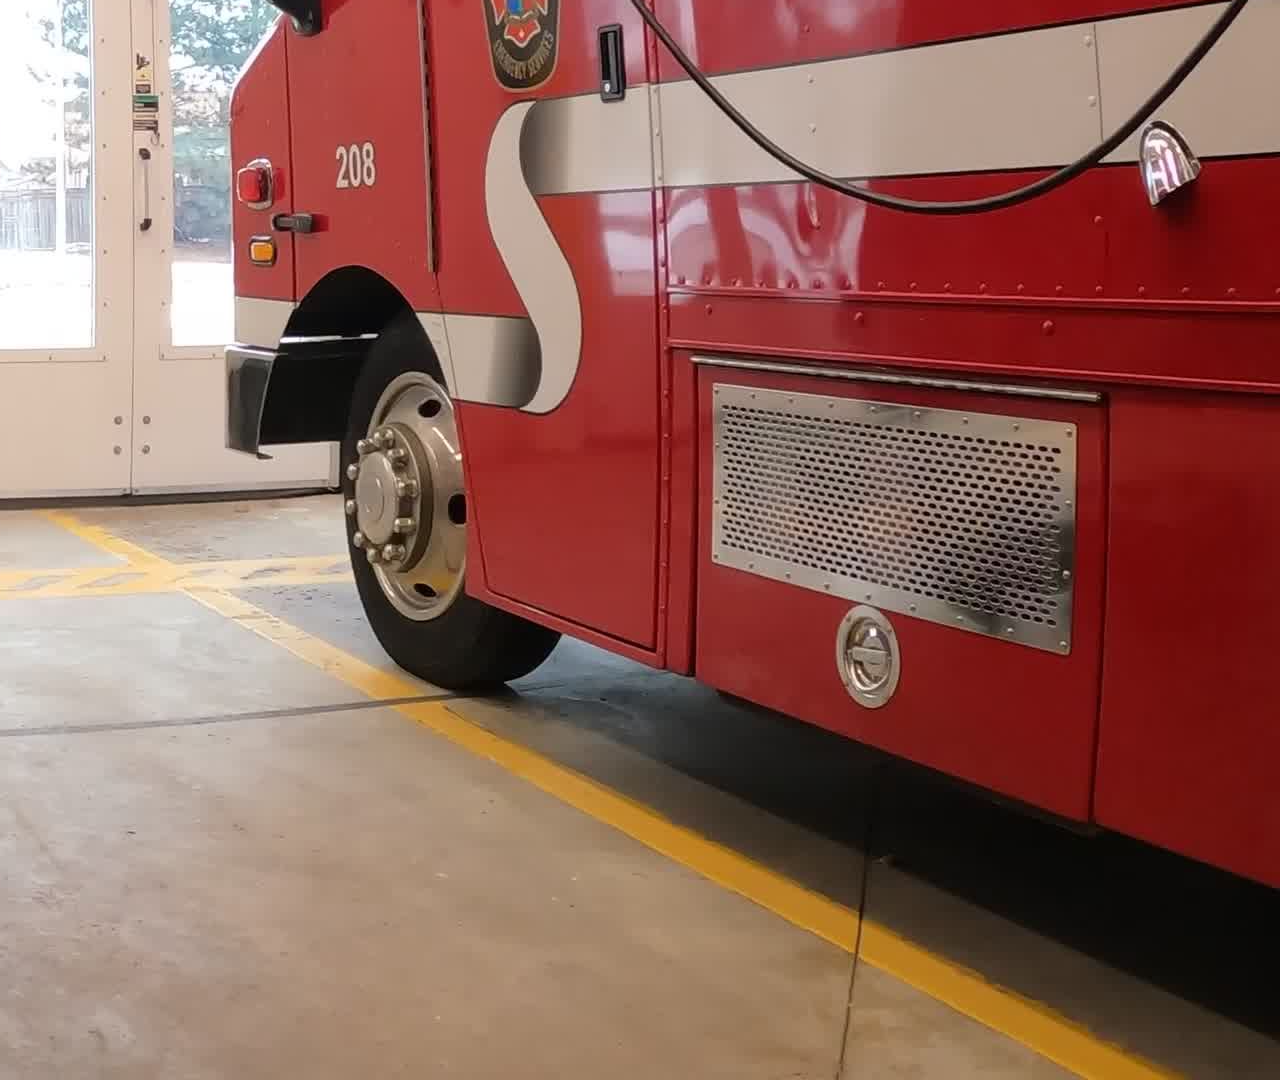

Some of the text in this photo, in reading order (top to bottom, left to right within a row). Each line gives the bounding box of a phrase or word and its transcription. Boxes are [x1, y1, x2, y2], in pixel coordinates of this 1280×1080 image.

[494, 30, 554, 80] EMERGENCY SERVICES
[336, 142, 376, 188] 208
